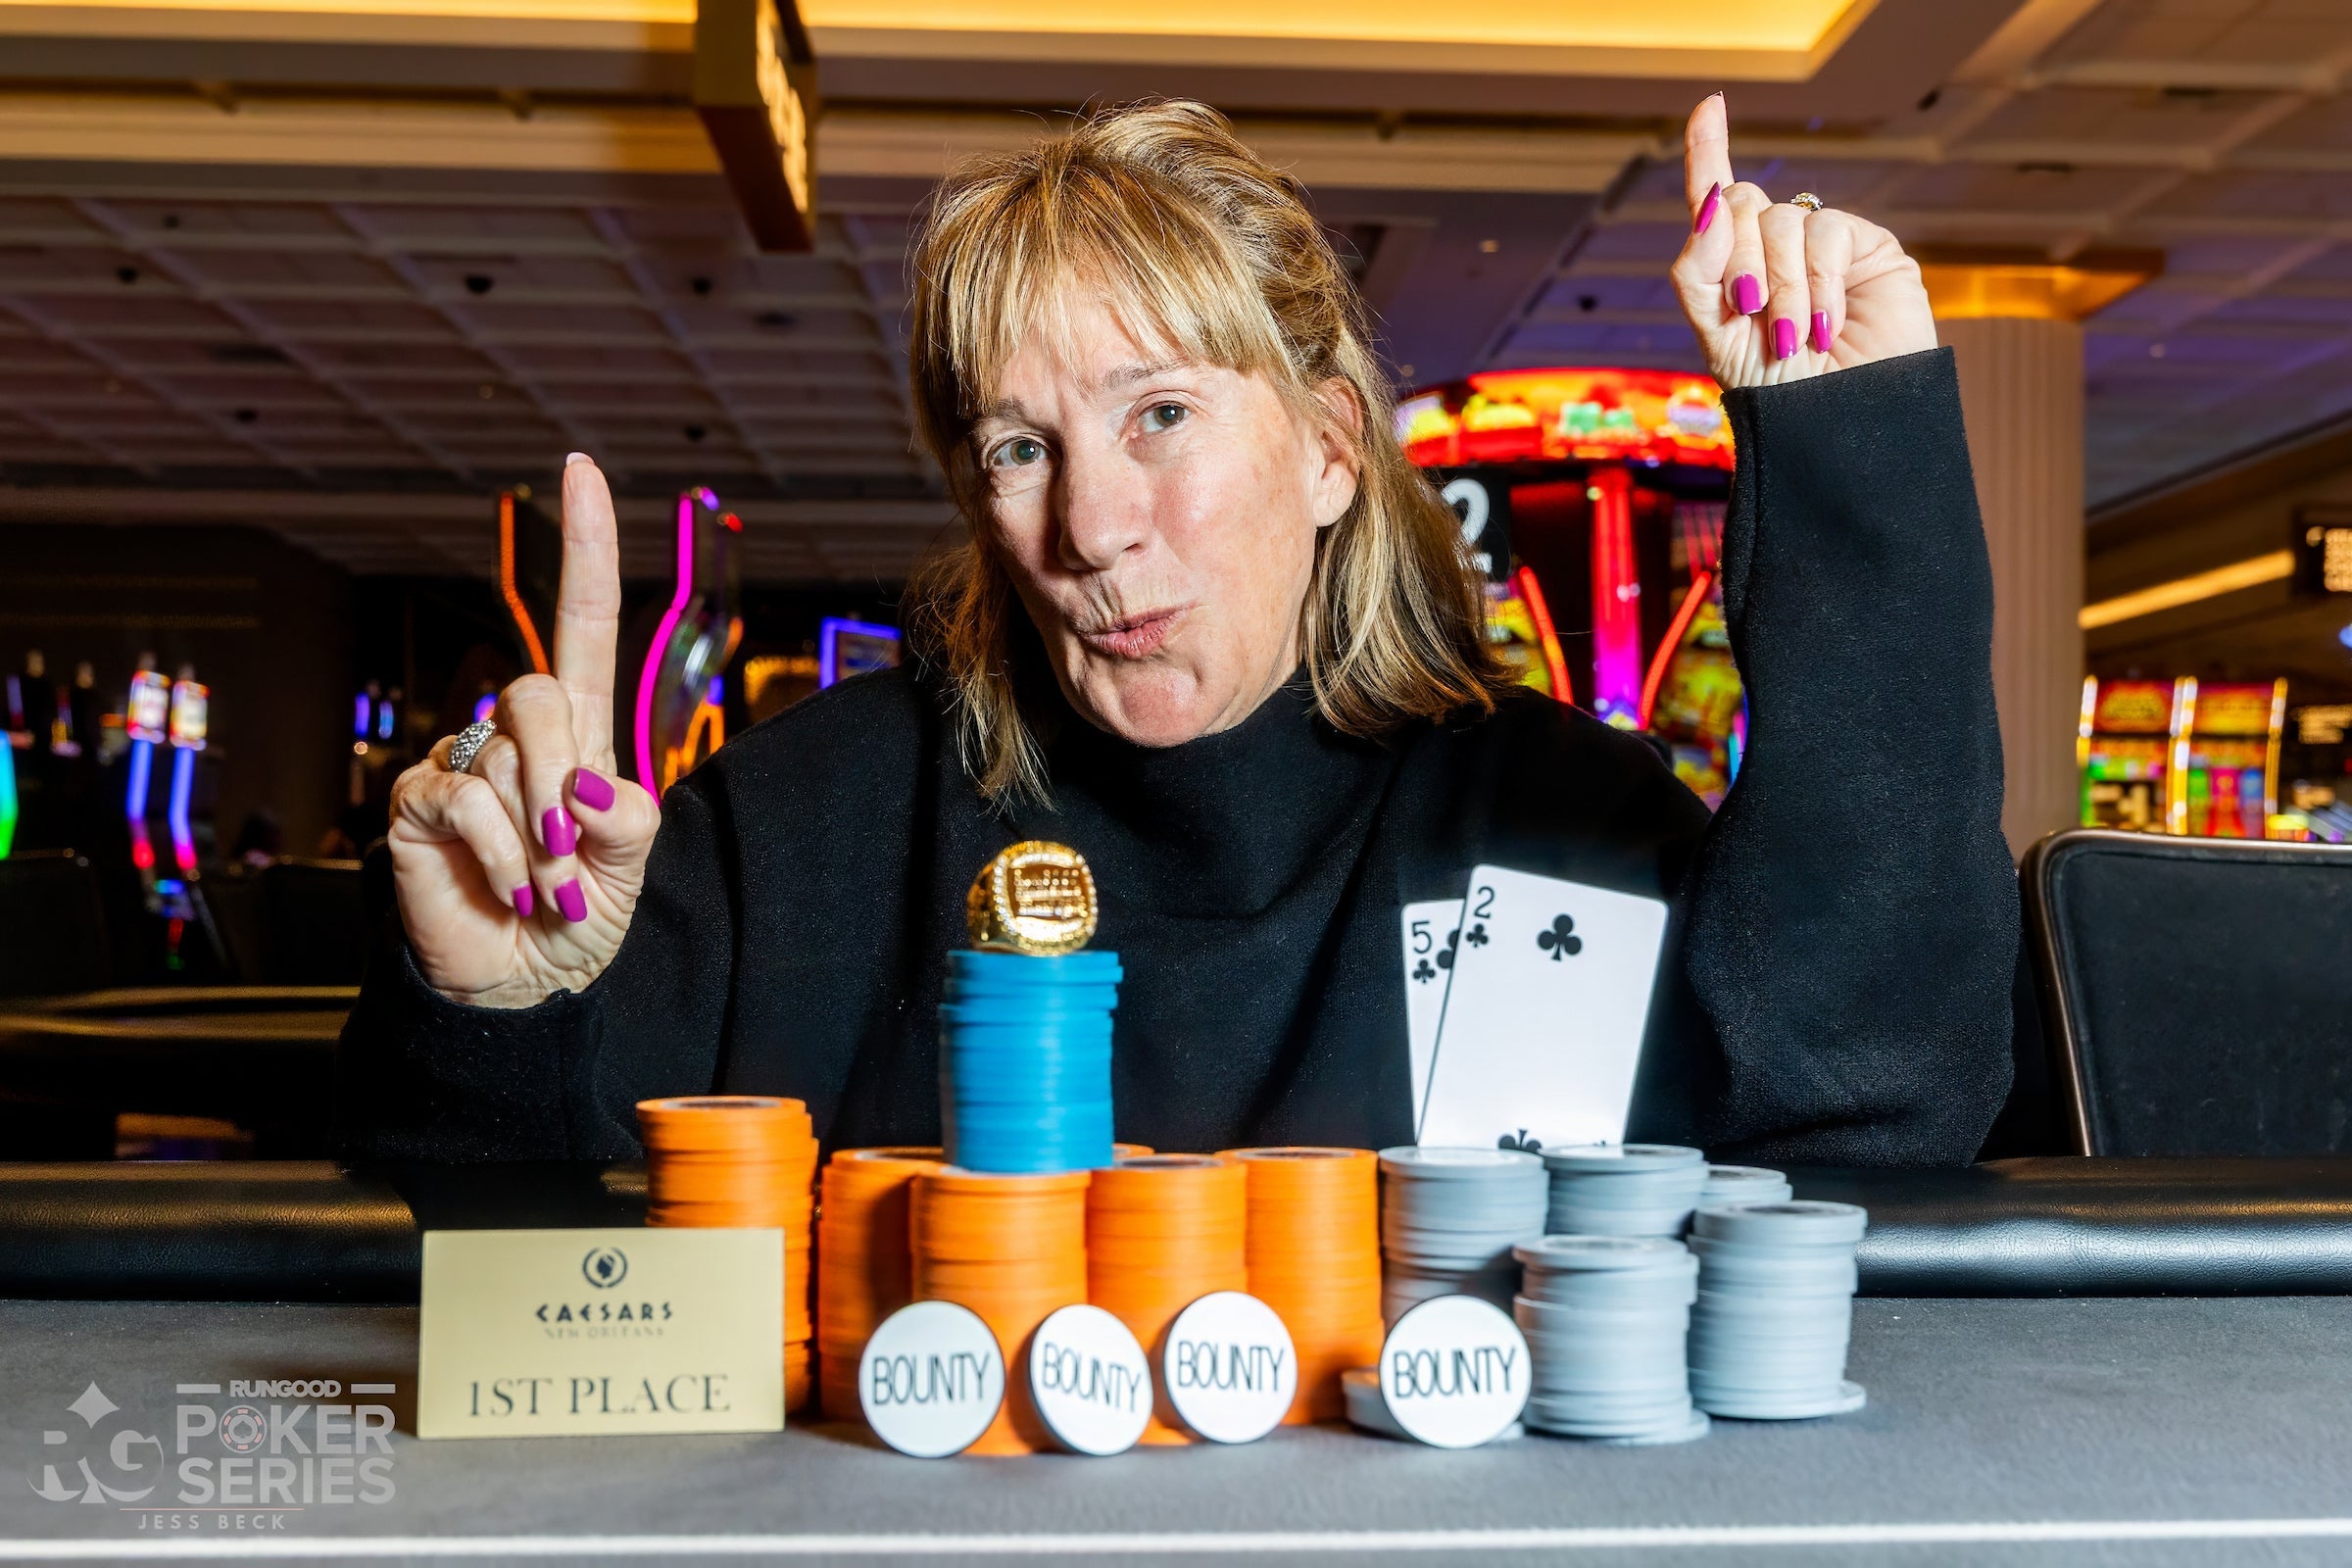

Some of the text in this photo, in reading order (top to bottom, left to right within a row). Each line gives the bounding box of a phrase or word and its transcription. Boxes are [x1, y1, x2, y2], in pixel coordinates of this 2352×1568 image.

[1473, 886, 1495, 919] 2
[1412, 920, 1433, 954] 5
[535, 1301, 673, 1322] CAESARS
[545, 1327, 579, 1340] NEW
[872, 1351, 991, 1405] BOUNTY
[1043, 1342, 1143, 1413] BOUNTY
[1178, 1340, 1284, 1393] BOUNTY
[1394, 1346, 1516, 1398] BOUNTY
[469, 1373, 731, 1417] 1ST PLACE
